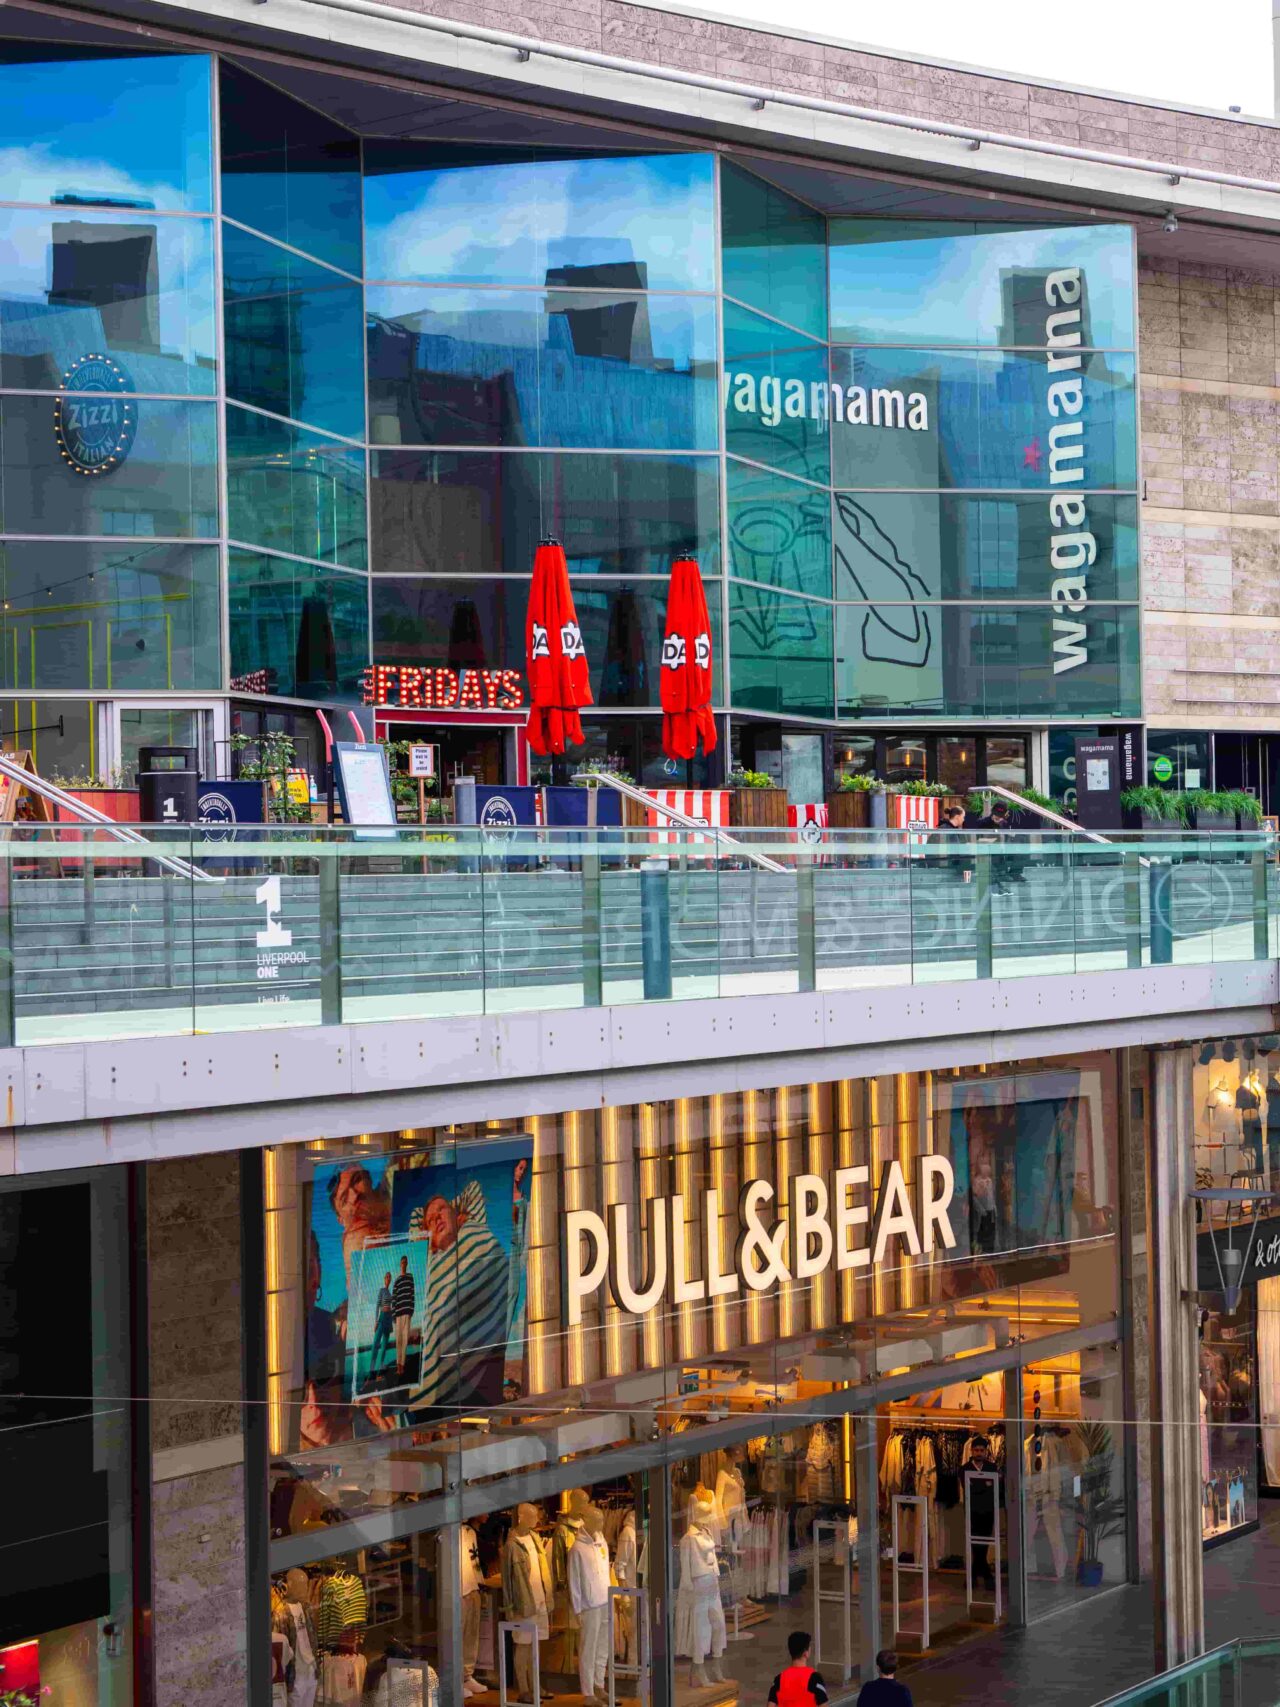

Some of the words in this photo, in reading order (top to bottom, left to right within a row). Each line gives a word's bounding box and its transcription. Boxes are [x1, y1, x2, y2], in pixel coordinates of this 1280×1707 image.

[68, 399, 119, 430] Zizzi
[73, 436, 114, 462] ITALIAN
[1045, 267, 1096, 674] wagamama
[372, 664, 524, 709] FRIDAYS
[1080, 744, 1114, 753] wagamama
[1124, 732, 1133, 780] wagamama
[163, 797, 179, 817] 1
[256, 875, 292, 947] 1
[257, 951, 309, 966] LIVERPOOL
[257, 966, 279, 979] ONE
[562, 1154, 957, 1326] PULL&BEAR
[1255, 1239, 1266, 1267] &
